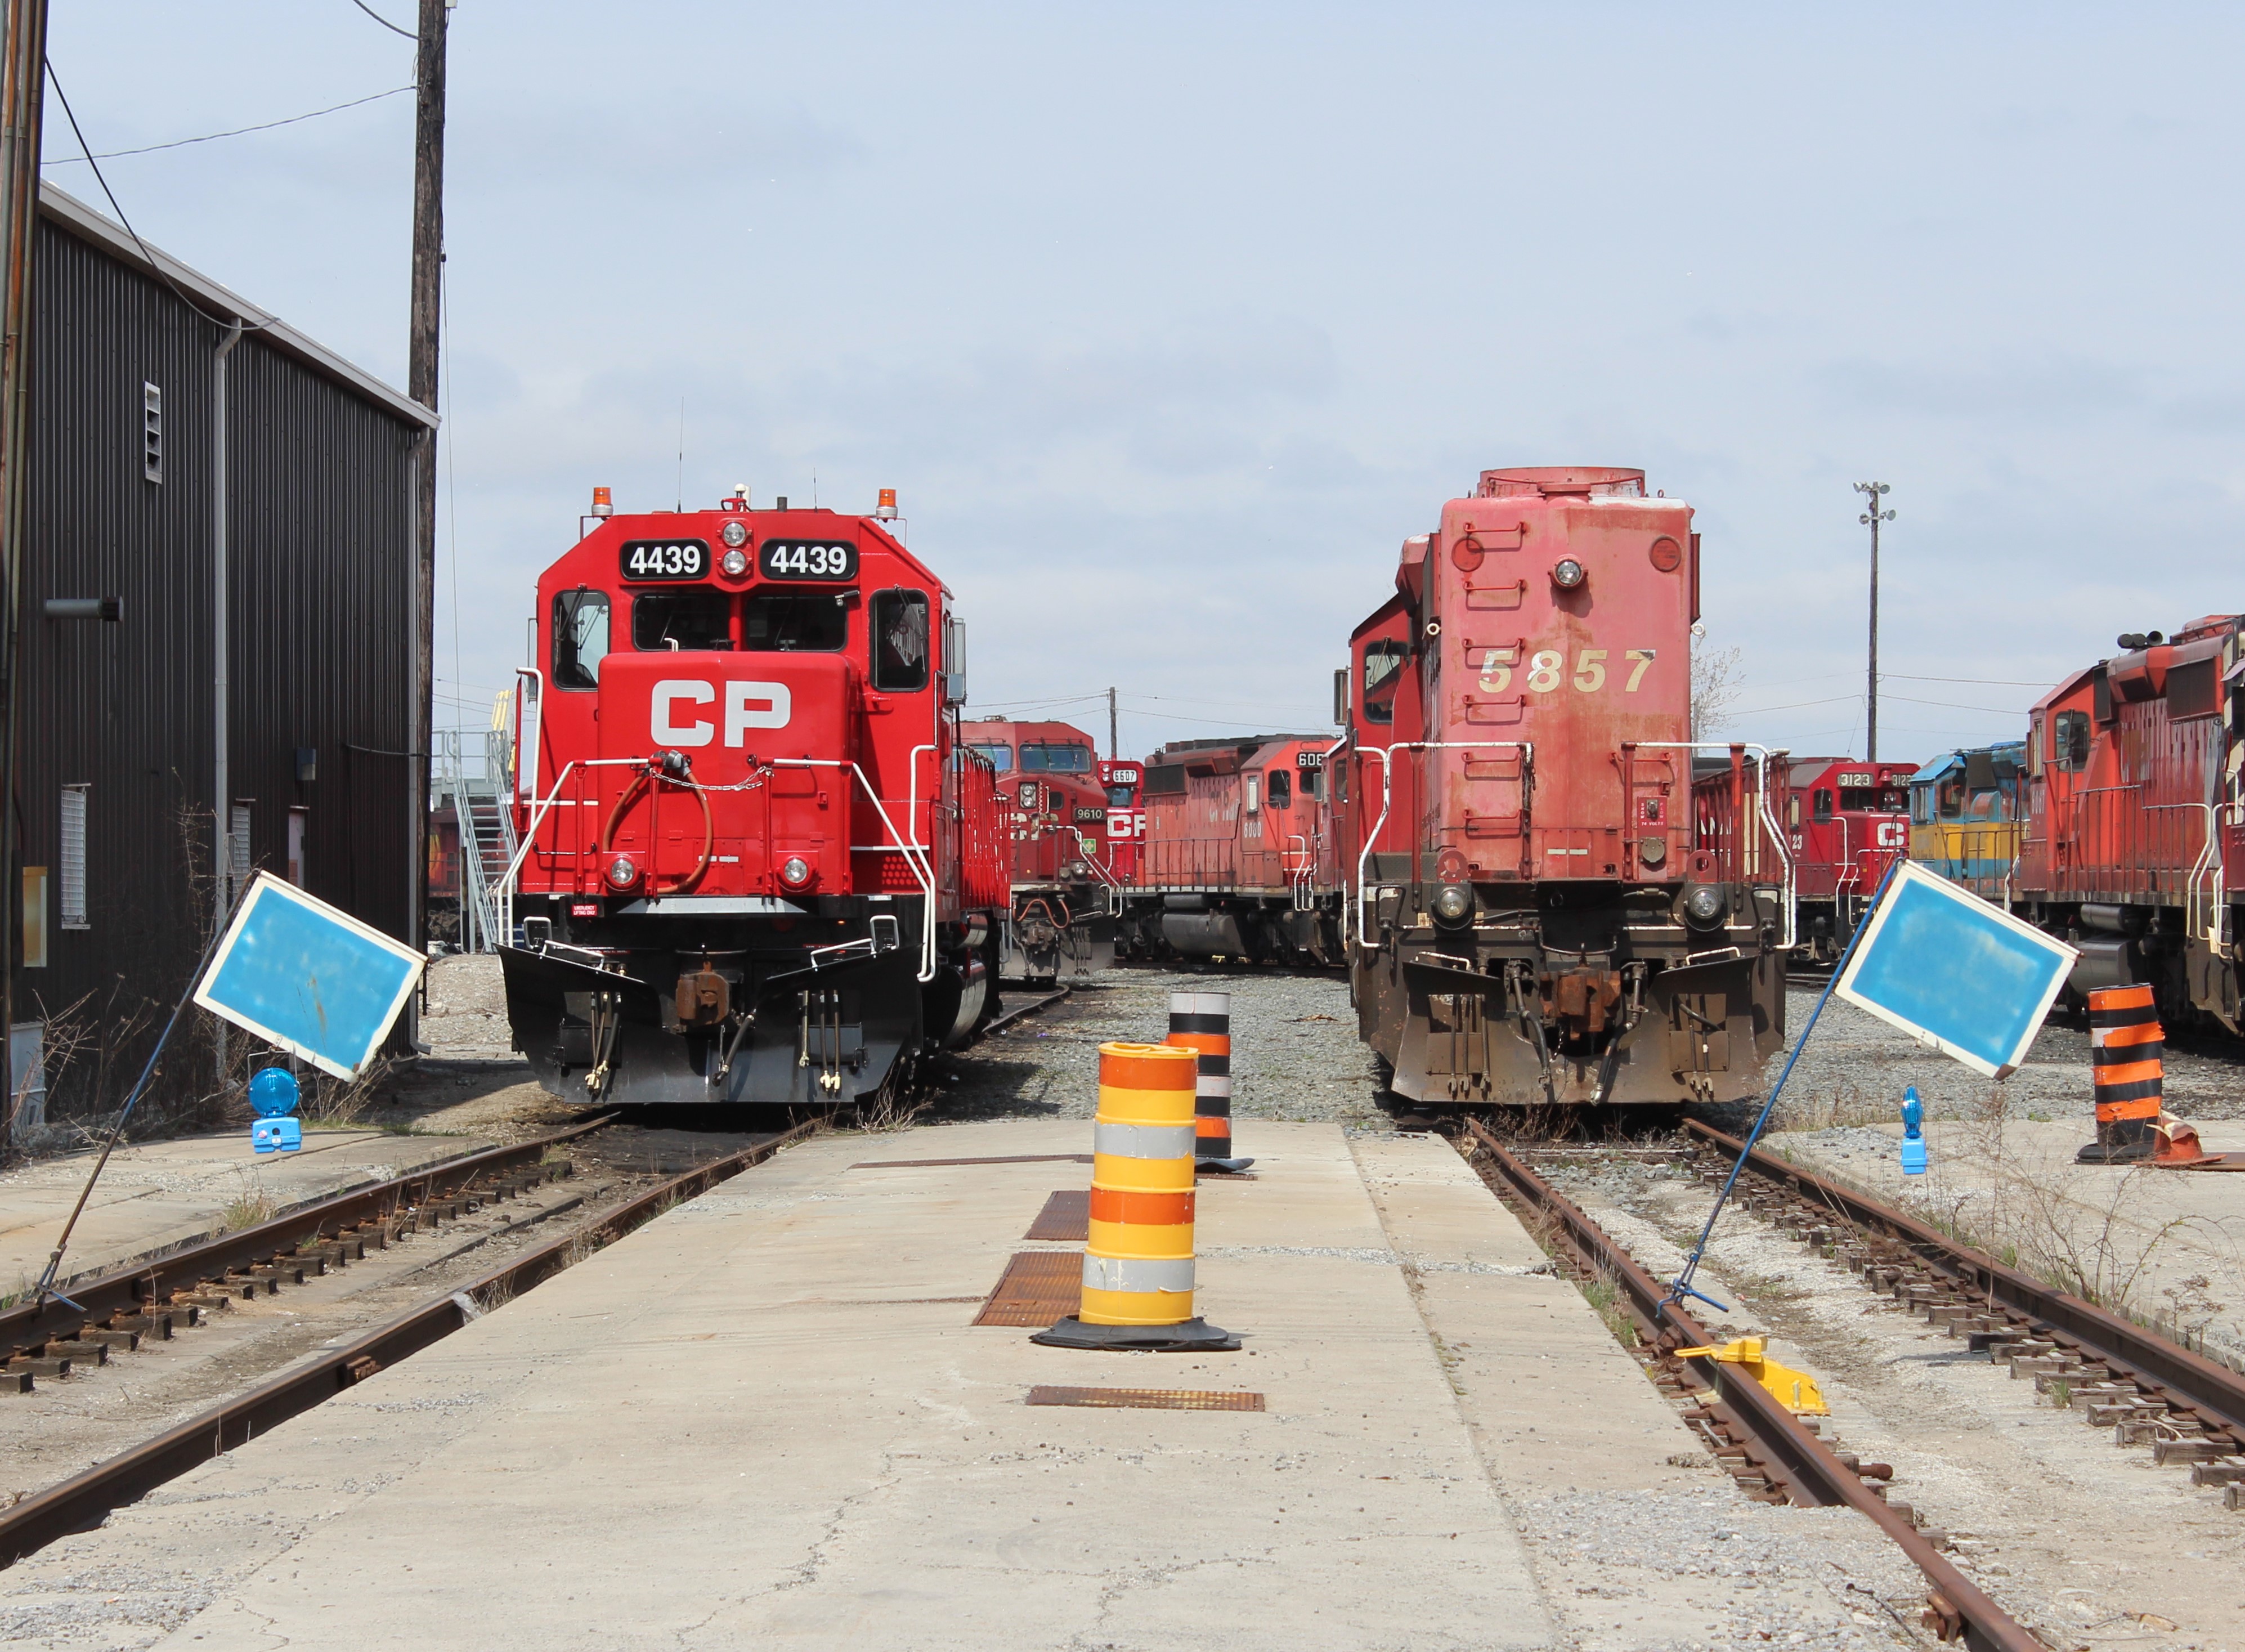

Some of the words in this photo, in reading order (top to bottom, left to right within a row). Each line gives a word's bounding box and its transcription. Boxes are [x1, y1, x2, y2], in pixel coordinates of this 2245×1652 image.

[630, 545, 701, 574] 4439
[770, 545, 847, 574] 4439
[1478, 649, 1656, 693] 5857
[651, 679, 791, 748] CP
[1299, 753, 1324, 766] 608
[1115, 771, 1135, 781] 6607
[1841, 773, 1870, 786] 3123
[1077, 809, 1103, 819] 9610
[1244, 821, 1262, 838] 6080
[1877, 822, 1905, 847] C
